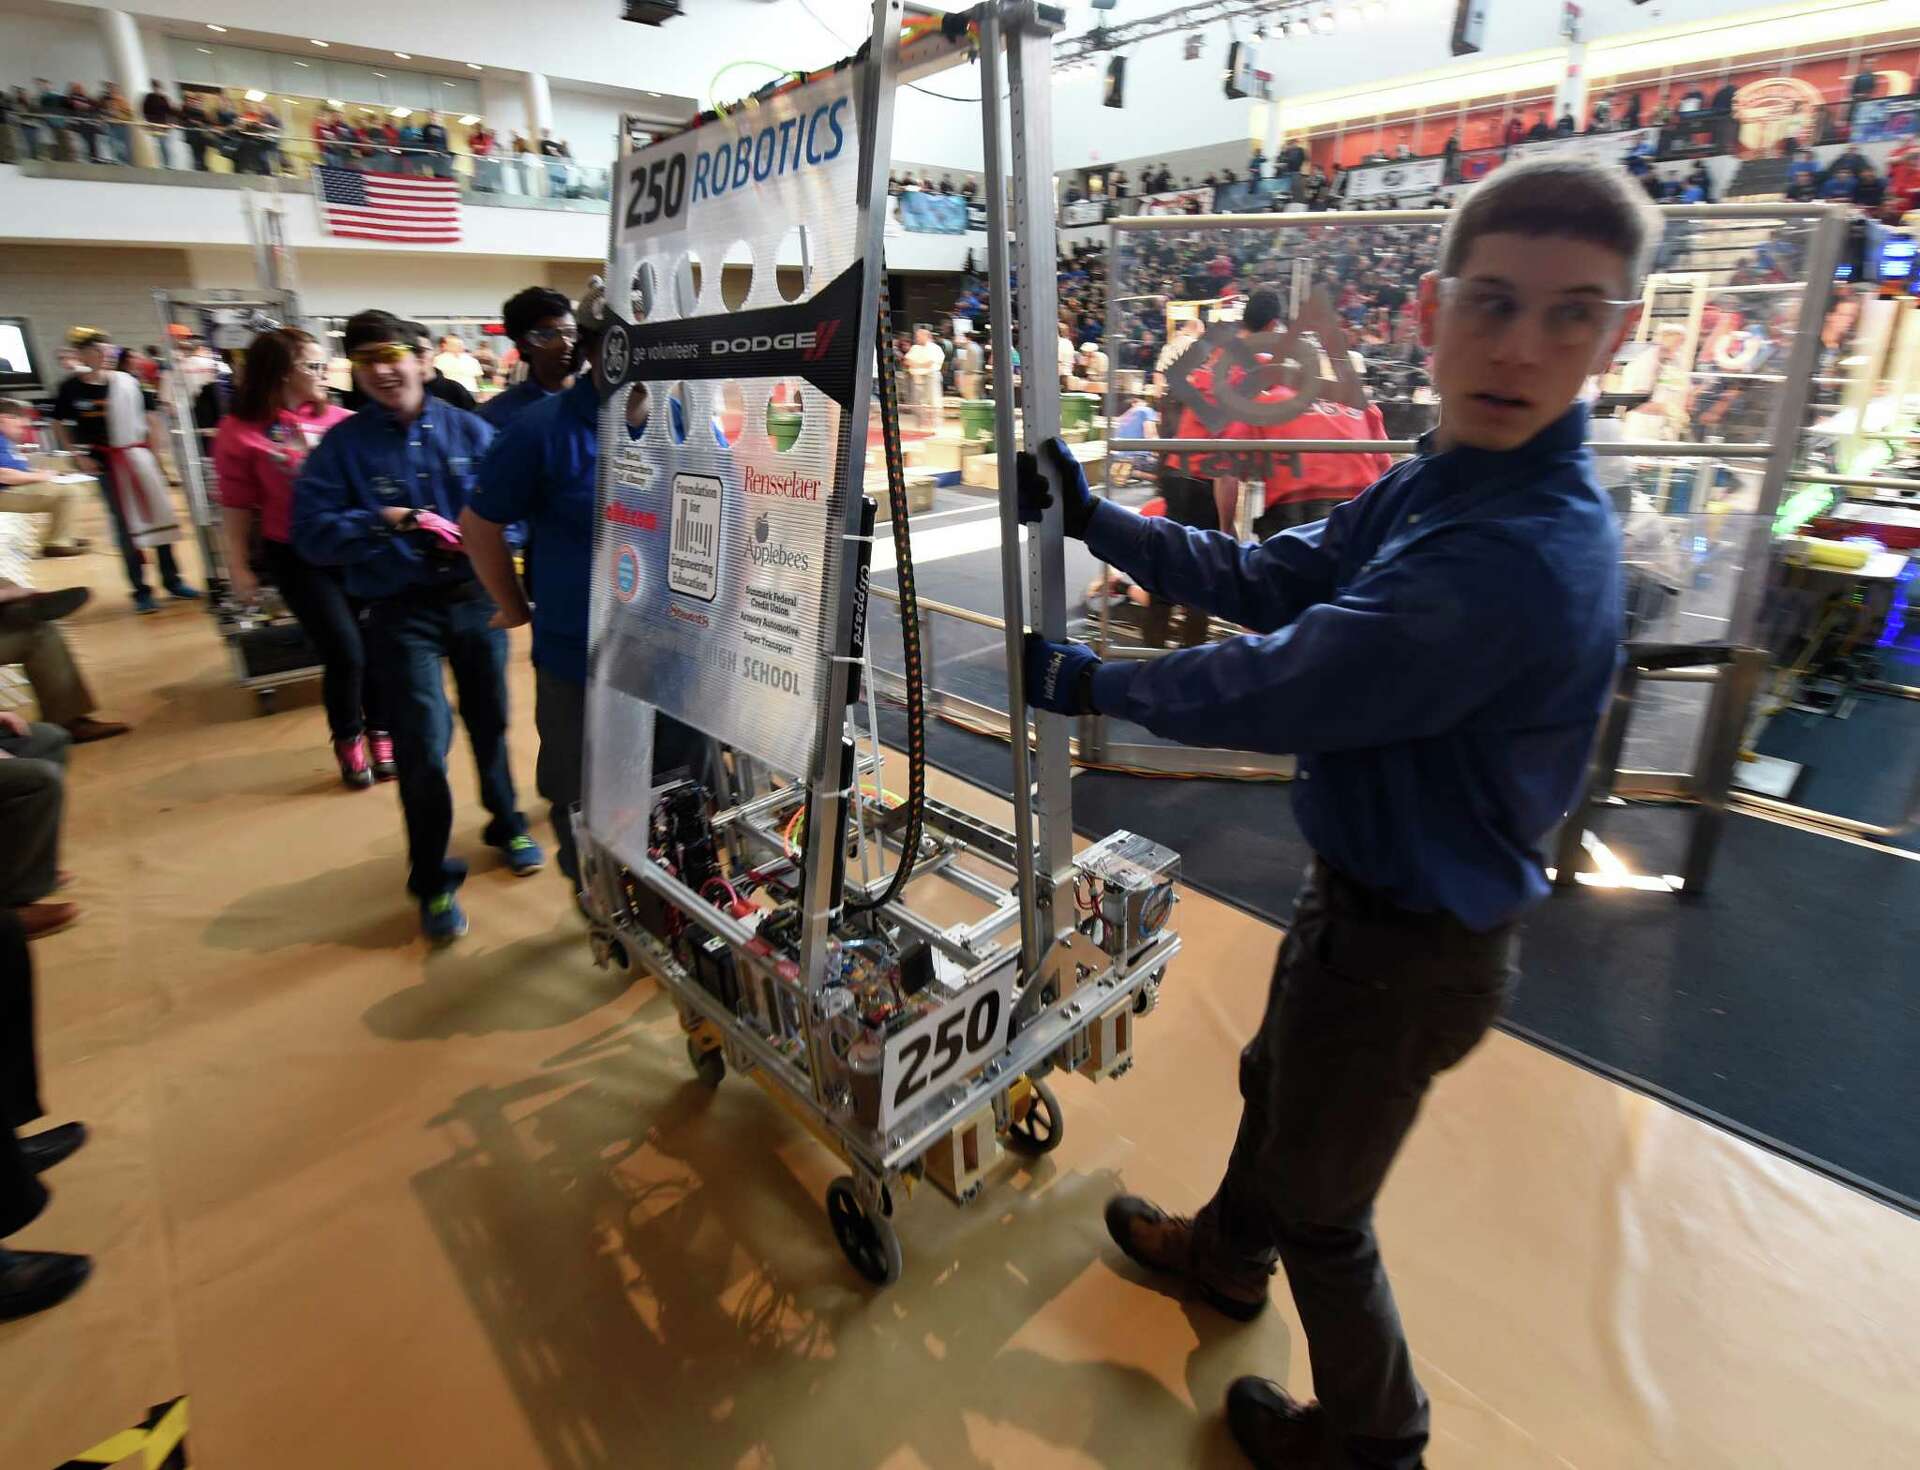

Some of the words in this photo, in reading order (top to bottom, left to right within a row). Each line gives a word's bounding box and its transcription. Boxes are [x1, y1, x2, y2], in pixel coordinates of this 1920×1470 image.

[625, 153, 687, 229] 250
[692, 97, 848, 202] ROBOTICS
[648, 342, 700, 361] volunteers
[711, 332, 817, 354] DODGE
[676, 481, 717, 498] Foundation
[744, 466, 821, 501] Rensselaer
[671, 553, 714, 578] Engineering
[672, 570, 708, 592] Education
[770, 602, 789, 616] Union
[853, 564, 871, 647] Clippard
[762, 617, 799, 637] Automotive
[761, 637, 792, 655] Transport
[743, 656, 801, 696] SCHOOL
[894, 989, 1000, 1111] 250
